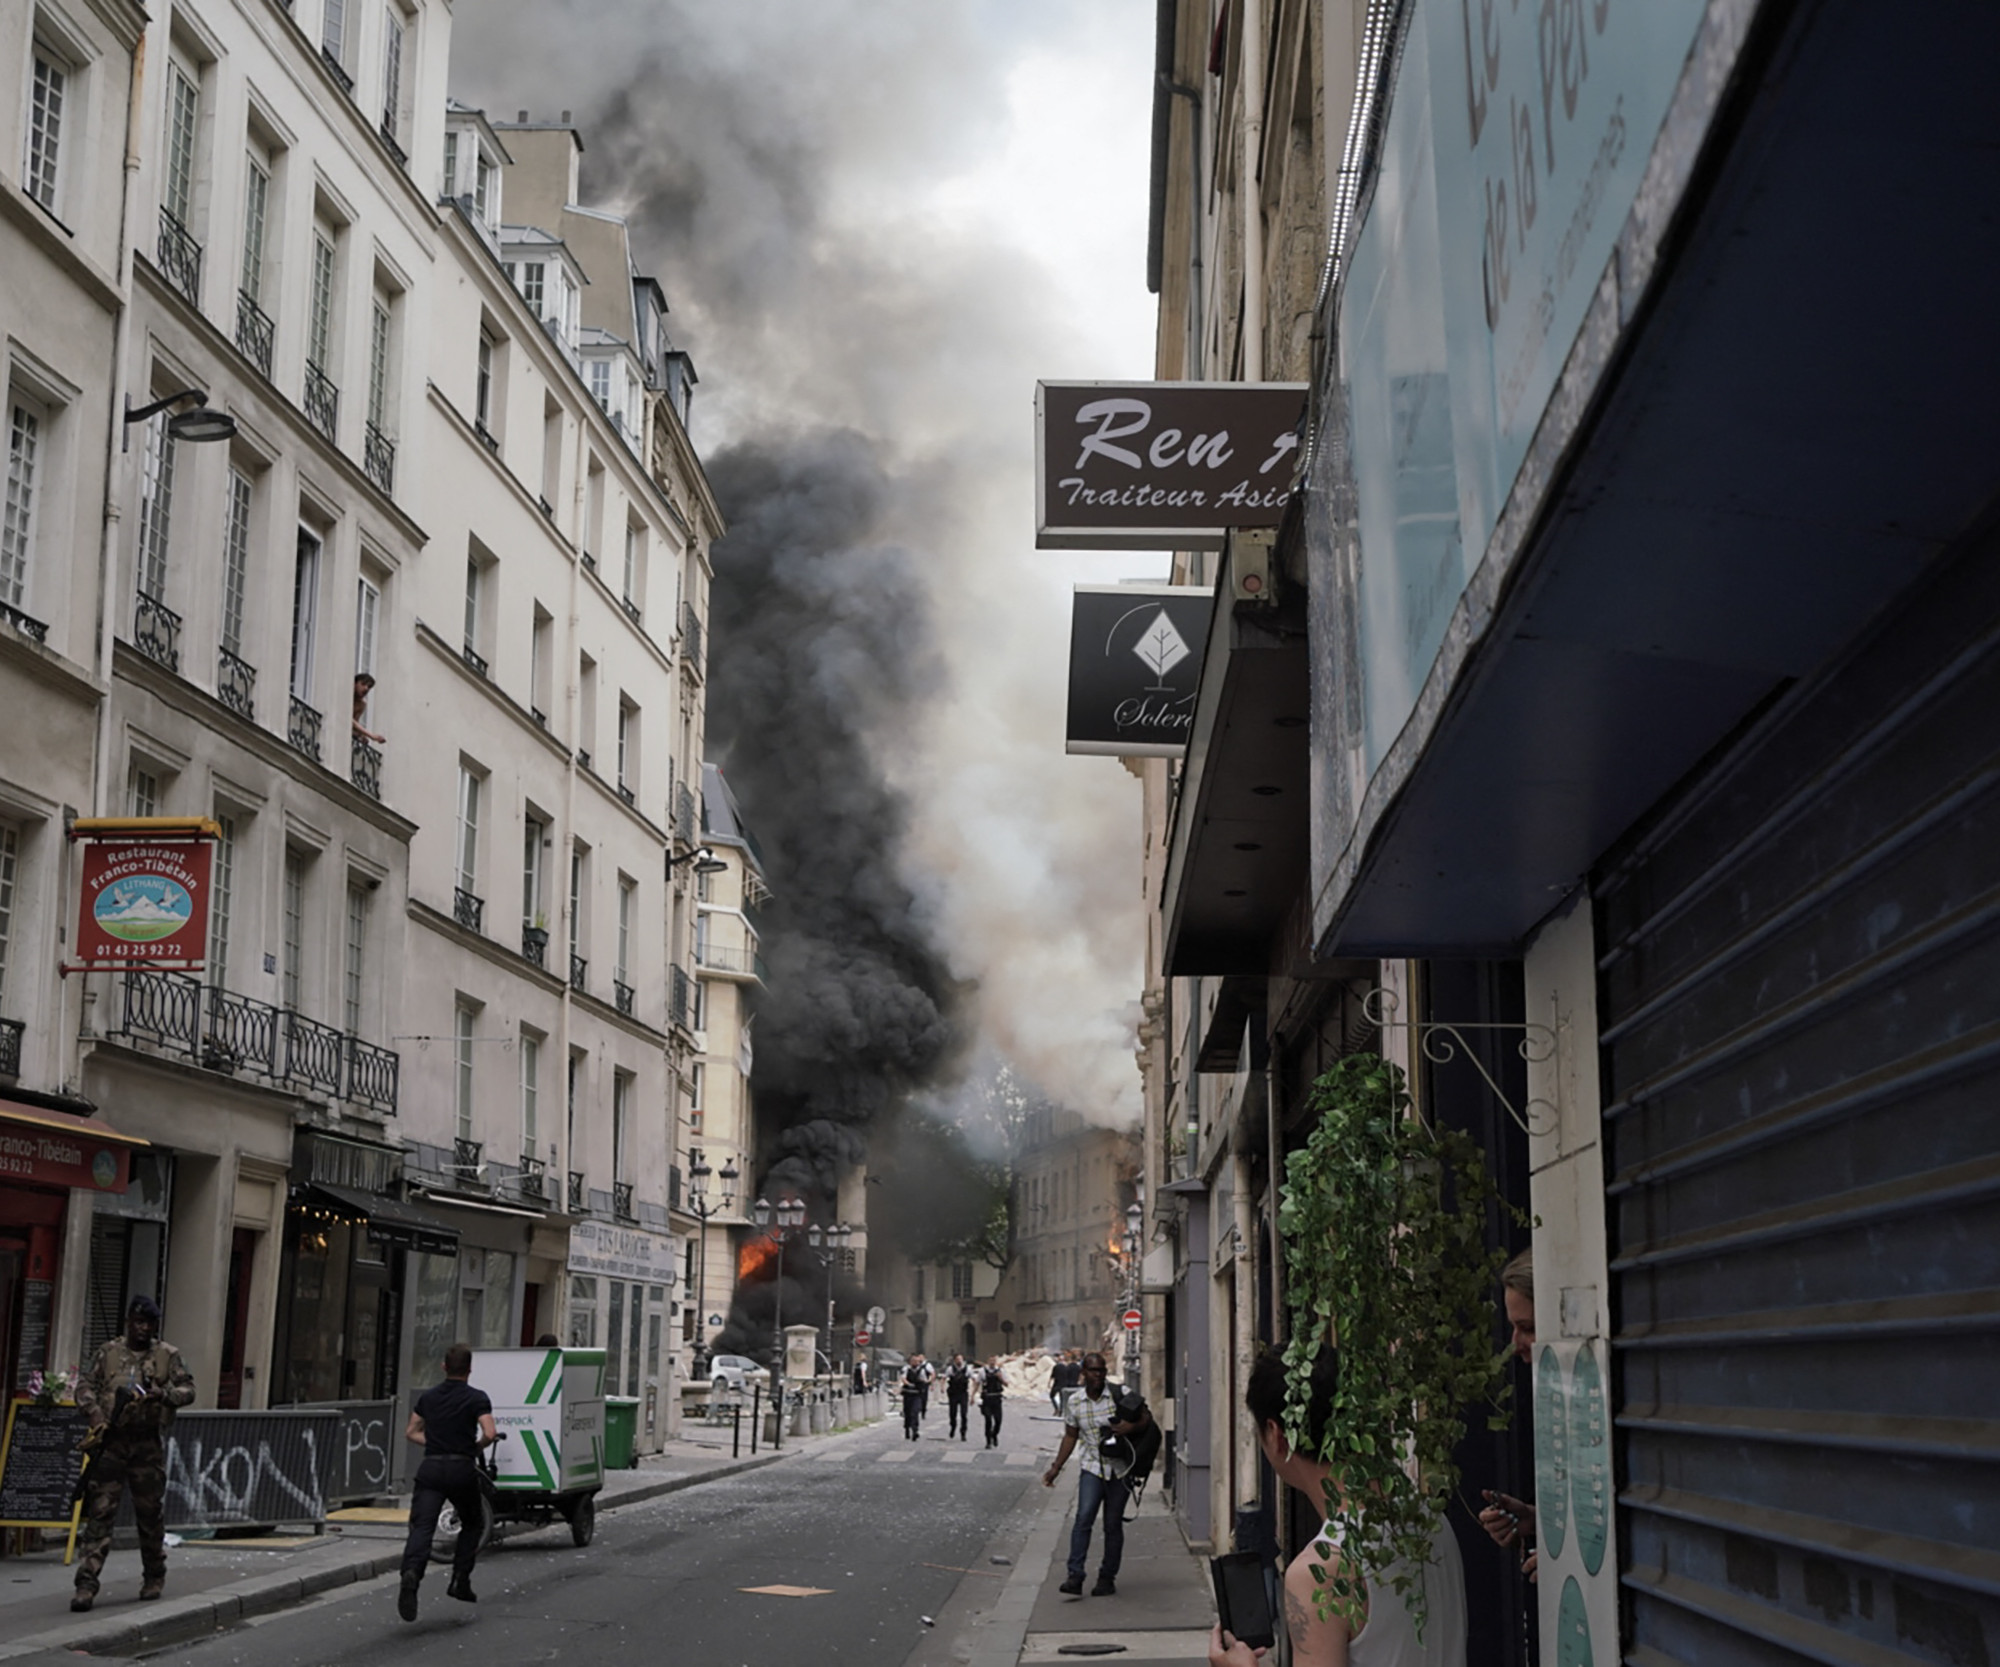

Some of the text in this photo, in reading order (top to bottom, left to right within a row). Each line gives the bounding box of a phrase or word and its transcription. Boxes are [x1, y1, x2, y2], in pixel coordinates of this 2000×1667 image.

[1483, 175, 1511, 334] de
[1510, 92, 1537, 253] la
[1075, 398, 1234, 471] Ren
[1058, 477, 1208, 506] Traiteur
[107, 847, 186, 865] Restaurant
[90, 859, 197, 890] Franco-Tibétain
[97, 944, 181, 956] 01 43 25 92 72
